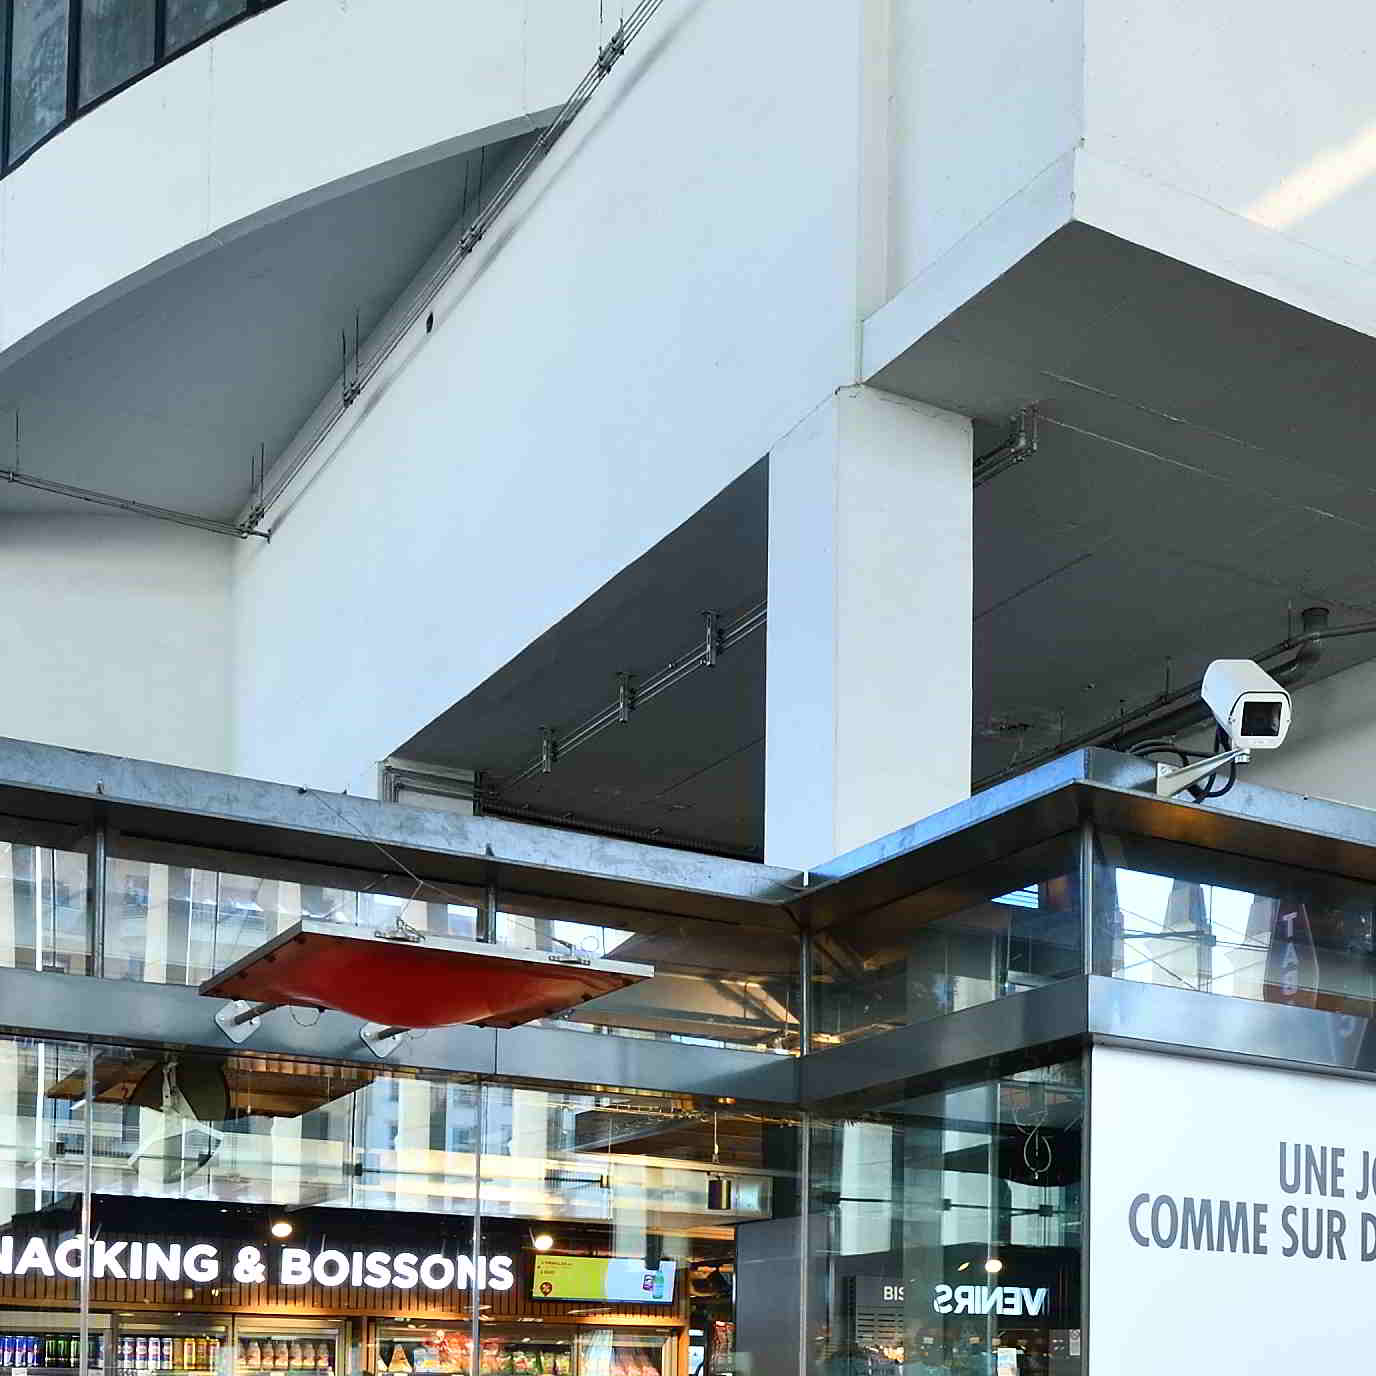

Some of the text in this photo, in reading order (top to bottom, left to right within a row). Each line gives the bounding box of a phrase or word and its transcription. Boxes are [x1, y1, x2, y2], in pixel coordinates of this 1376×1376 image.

[1279, 1142, 1346, 1198] UNE
[1128, 1192, 1268, 1255] COMME
[1282, 1204, 1347, 1261] SUR
[233, 1246, 266, 1284] &
[280, 1247, 515, 1292] BOISSONS
